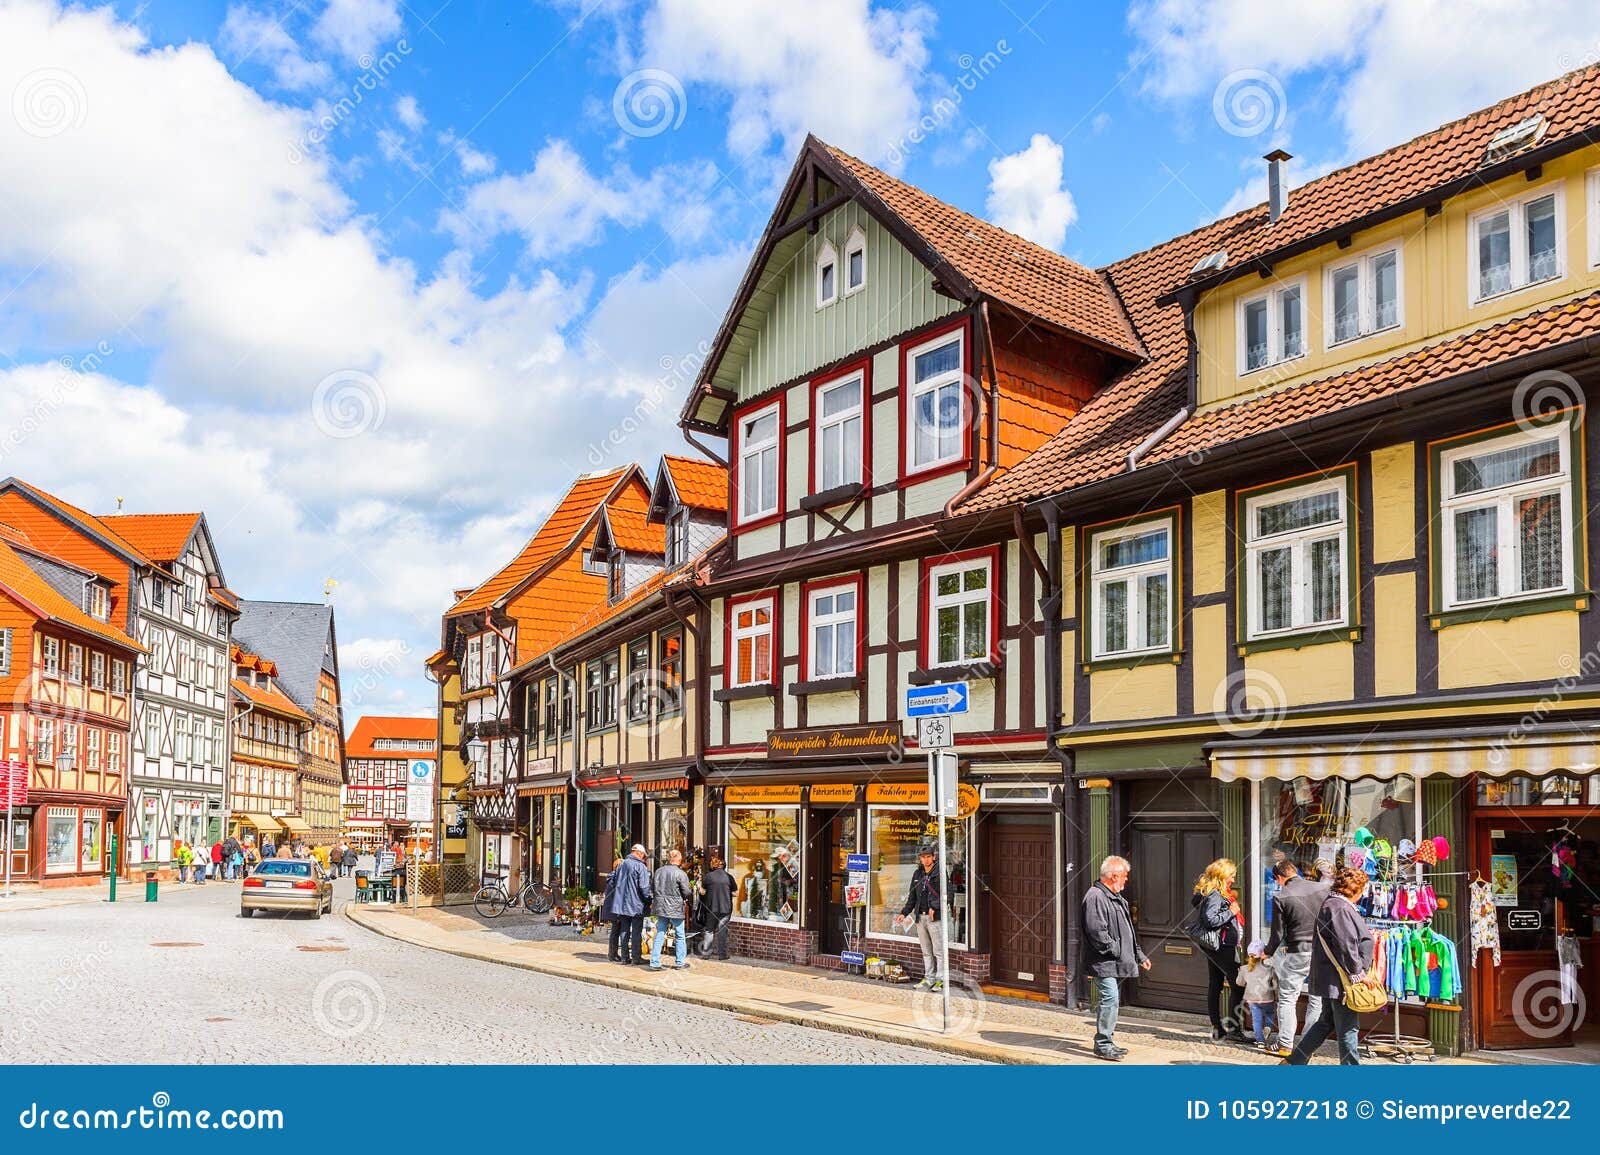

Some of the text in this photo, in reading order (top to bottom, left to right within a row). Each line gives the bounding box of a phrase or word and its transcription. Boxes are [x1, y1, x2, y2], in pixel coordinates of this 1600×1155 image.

[829, 727, 898, 748] Bimmelbahn
[812, 786, 853, 796] Fahrkarten hier
[908, 788, 928, 799] zum
[448, 825, 465, 835] sky
